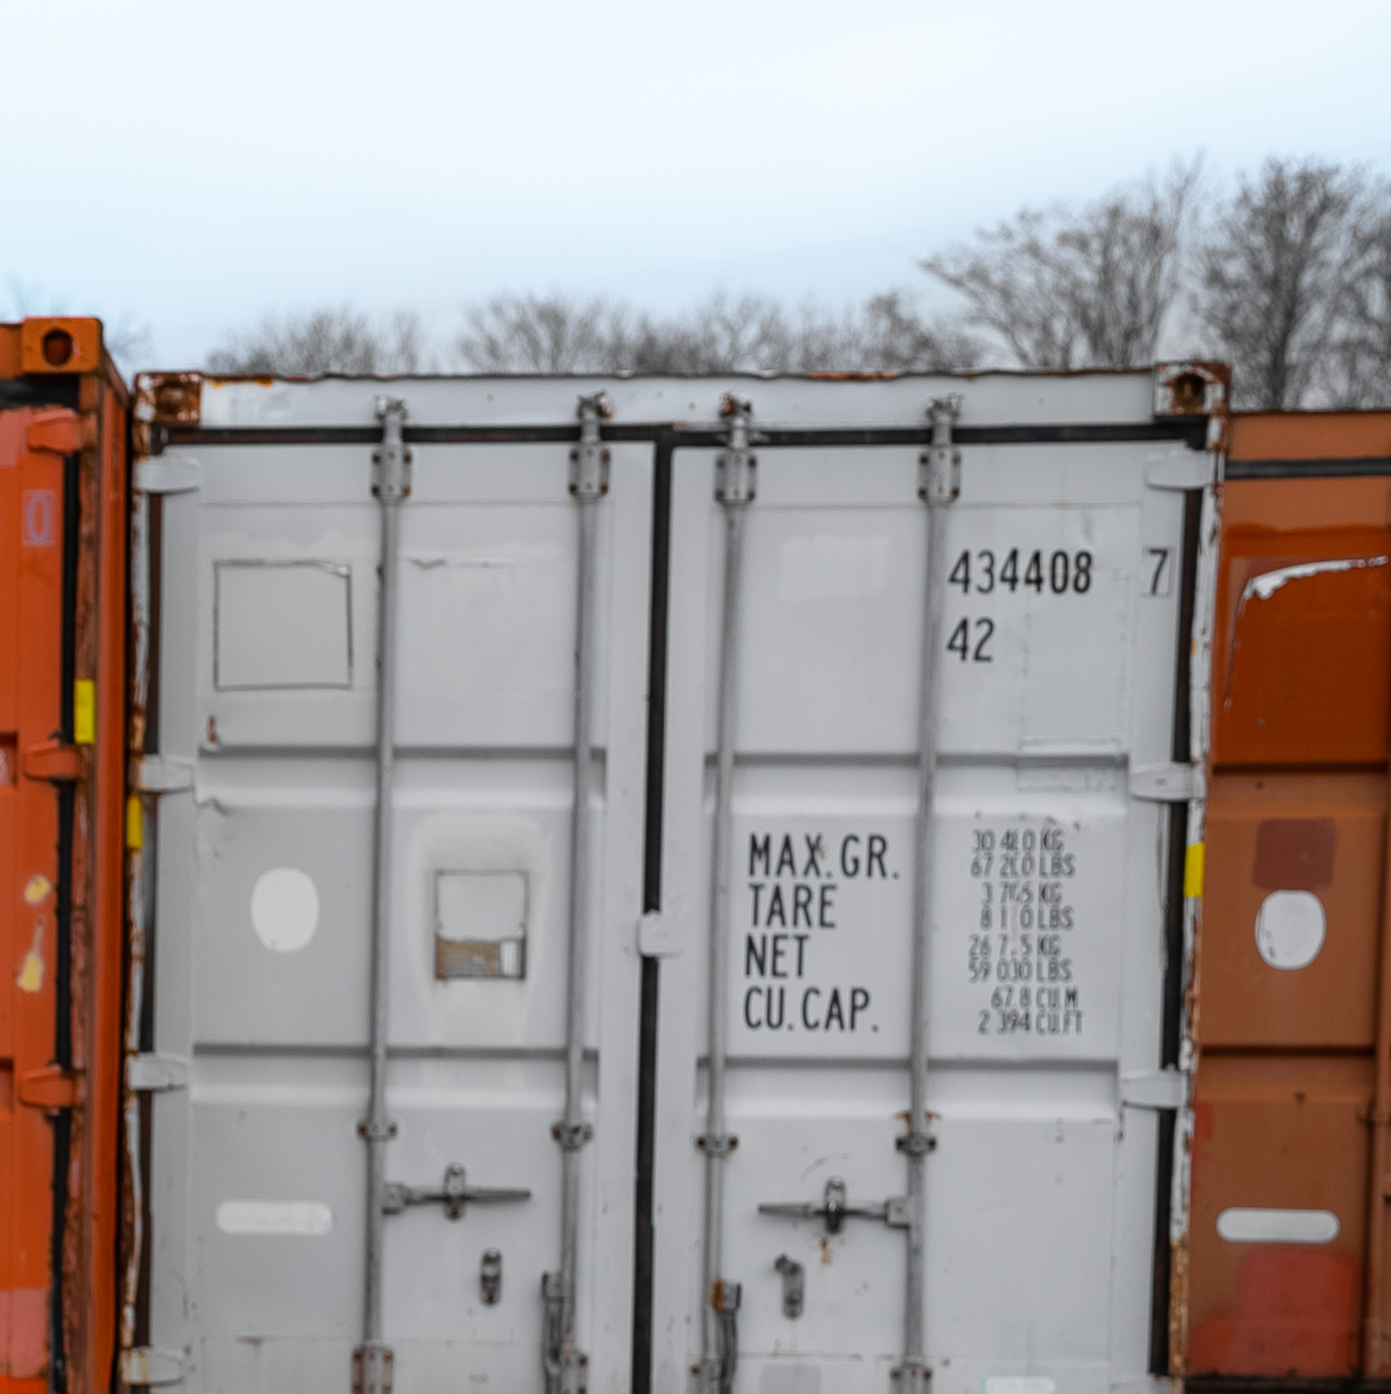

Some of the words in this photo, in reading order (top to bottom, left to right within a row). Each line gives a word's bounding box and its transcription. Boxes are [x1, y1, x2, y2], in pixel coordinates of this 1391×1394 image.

[948, 549, 1092, 594] 434408
[1148, 549, 1169, 596] 7
[946, 617, 995, 663] 42
[1038, 852, 1076, 878] LBS
[748, 882, 838, 928] TARE
[1037, 904, 1075, 931] LBS
[745, 933, 809, 978] NET
[1036, 958, 1073, 983] LBS
